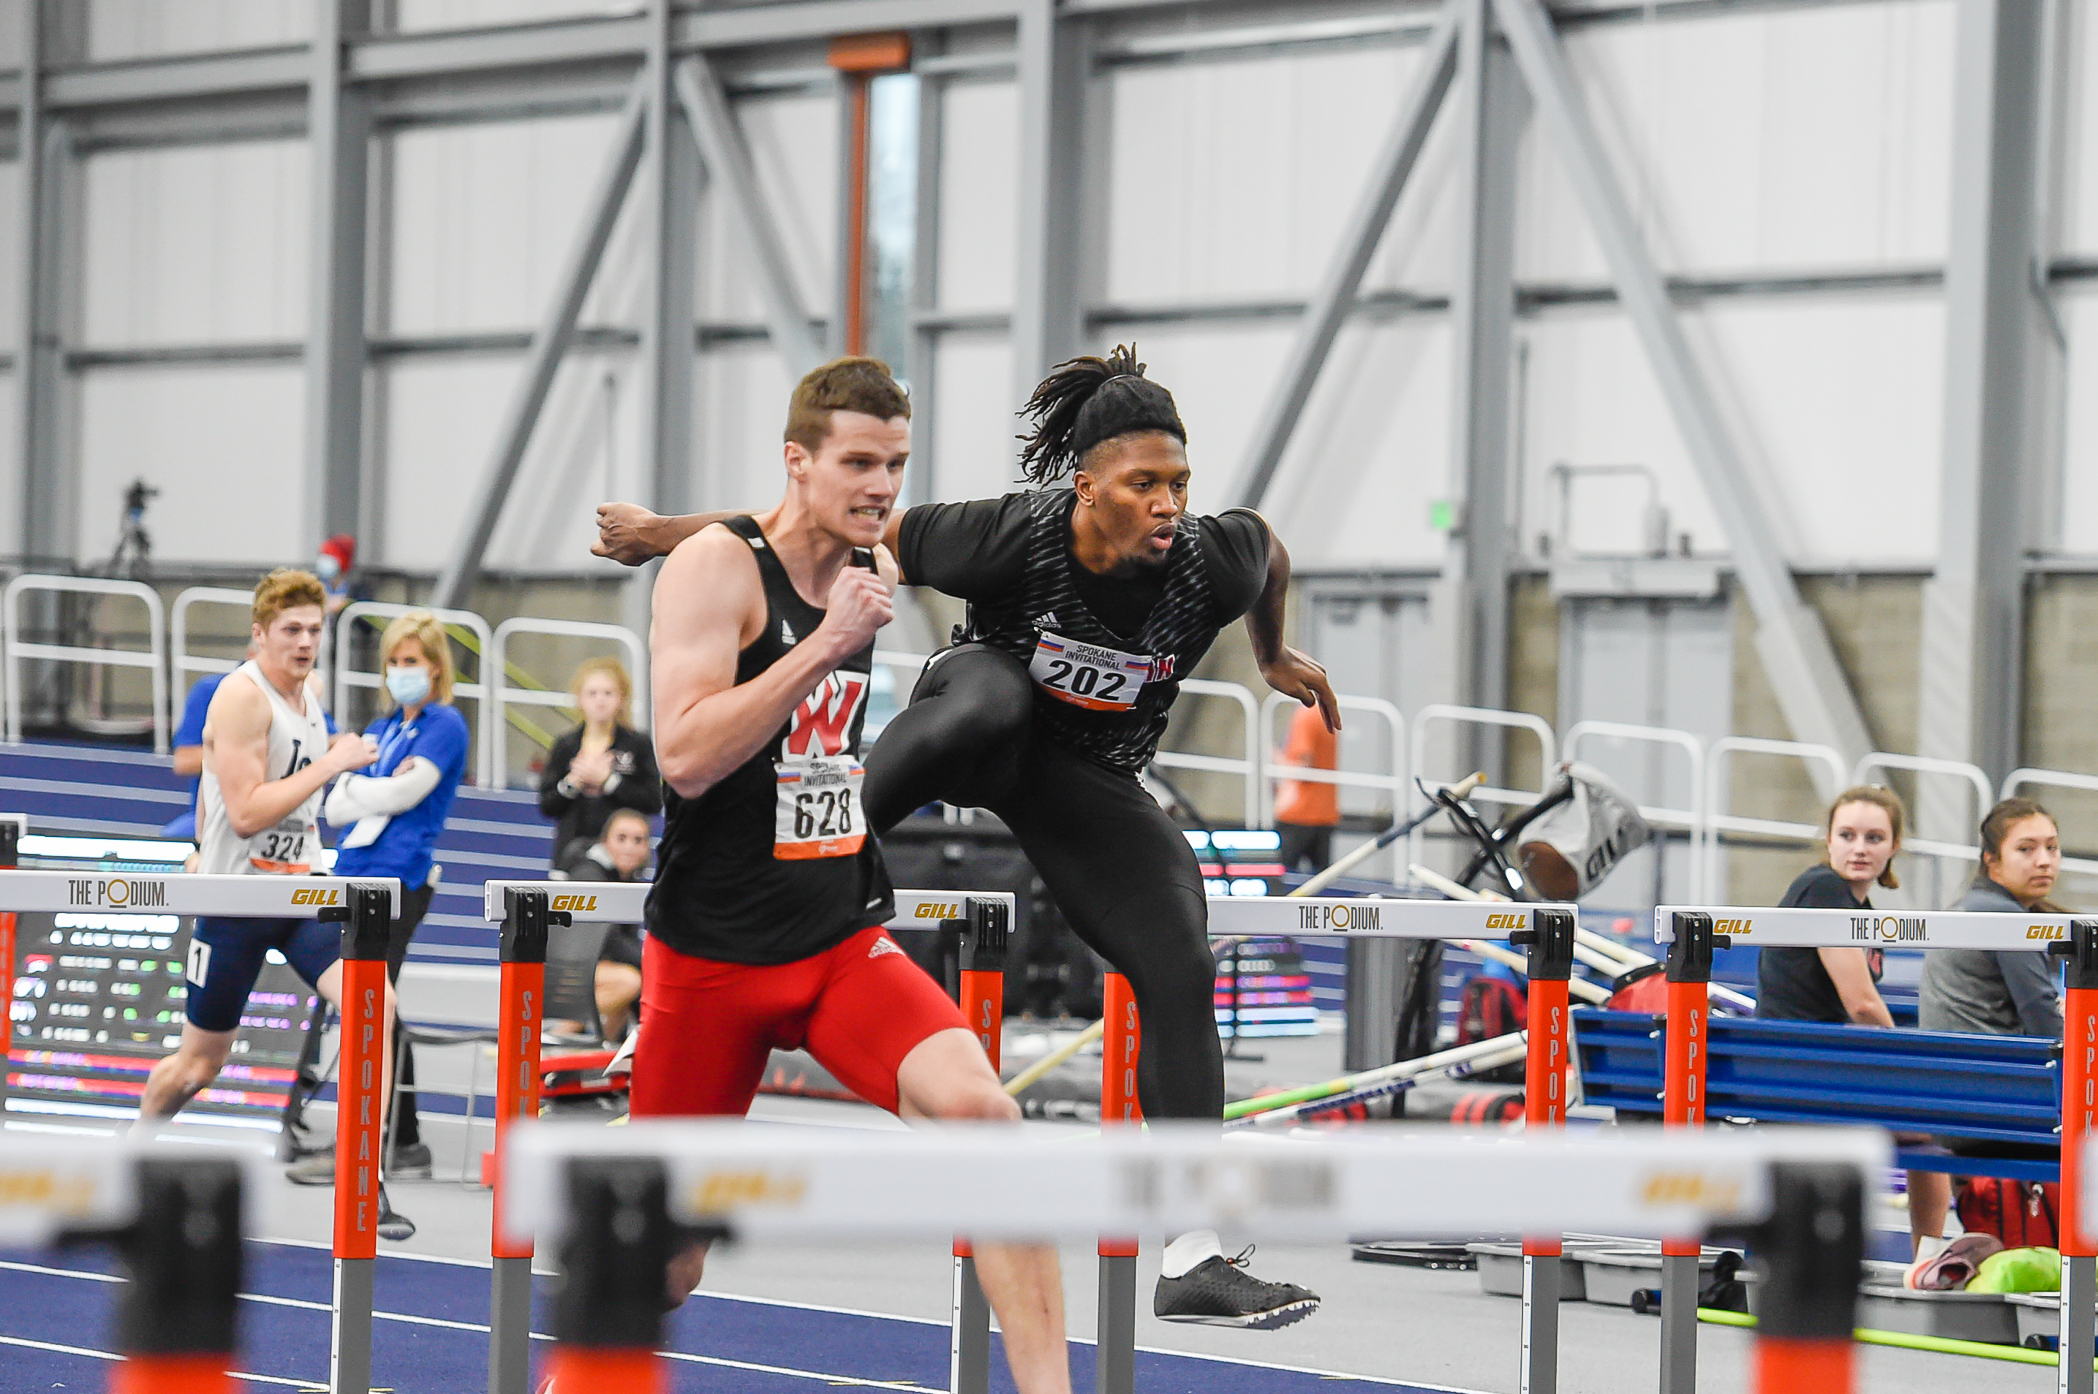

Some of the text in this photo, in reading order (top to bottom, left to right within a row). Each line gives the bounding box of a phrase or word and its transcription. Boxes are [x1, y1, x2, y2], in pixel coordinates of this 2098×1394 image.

[1065, 650, 1121, 671] INVITATIONAL
[1076, 644, 1118, 662] SPOKANE
[1042, 659, 1127, 702] 202
[804, 772, 847, 787] INVITATIONAL
[793, 787, 852, 839] 628
[261, 832, 304, 862] 324
[68, 880, 92, 905] THE
[290, 888, 339, 906] GILL
[551, 895, 598, 911] GILL
[914, 902, 958, 919] GILL
[1298, 905, 1319, 930] THE
[1485, 913, 1526, 929] GILL
[1713, 919, 1753, 935] GILL
[1850, 917, 1869, 940] THE
[2025, 925, 2064, 940] GILL
[193, 945, 202, 981] 1
[356, 988, 375, 1232] SPOKANE
